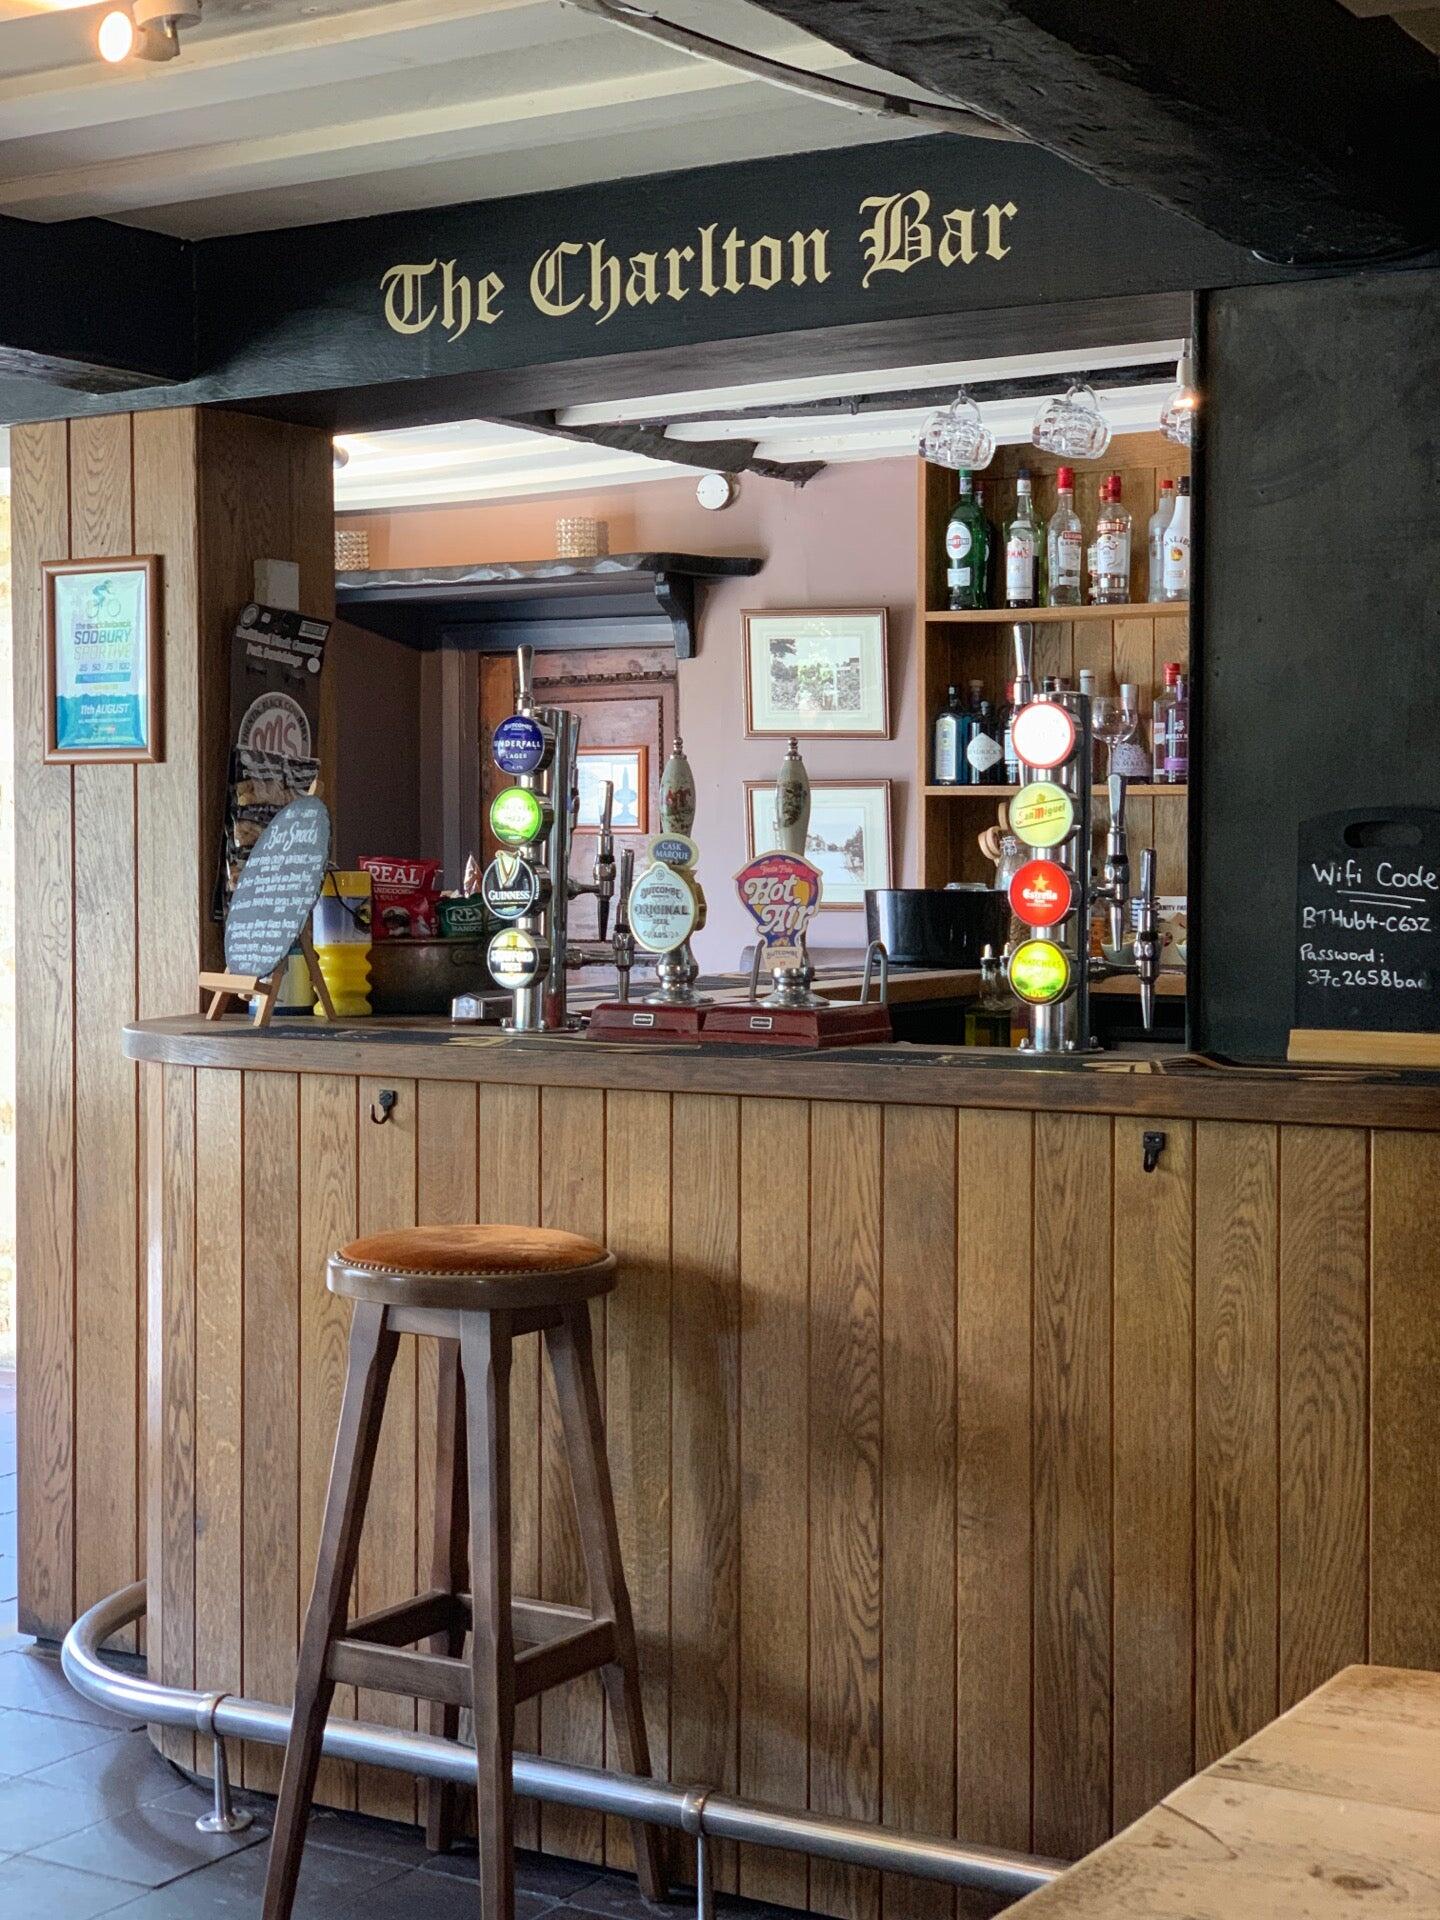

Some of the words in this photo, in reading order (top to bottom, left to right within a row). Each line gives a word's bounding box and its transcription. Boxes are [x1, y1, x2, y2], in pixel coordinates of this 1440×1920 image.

[380, 258, 504, 342] The
[529, 223, 830, 325] Charlton
[858, 189, 1018, 288] Bar
[73, 628, 132, 646] SODBURY
[95, 703, 130, 716] AUGUST
[655, 849, 689, 861] MARQUE
[661, 842, 682, 851] CASK
[368, 864, 420, 885] REAL
[1311, 859, 1363, 887] Wifi
[1376, 862, 1439, 890] Code
[488, 890, 531, 901] GUINNESS
[744, 874, 797, 905] Hot
[635, 904, 690, 917] ORIGINAL
[757, 898, 815, 933] Air
